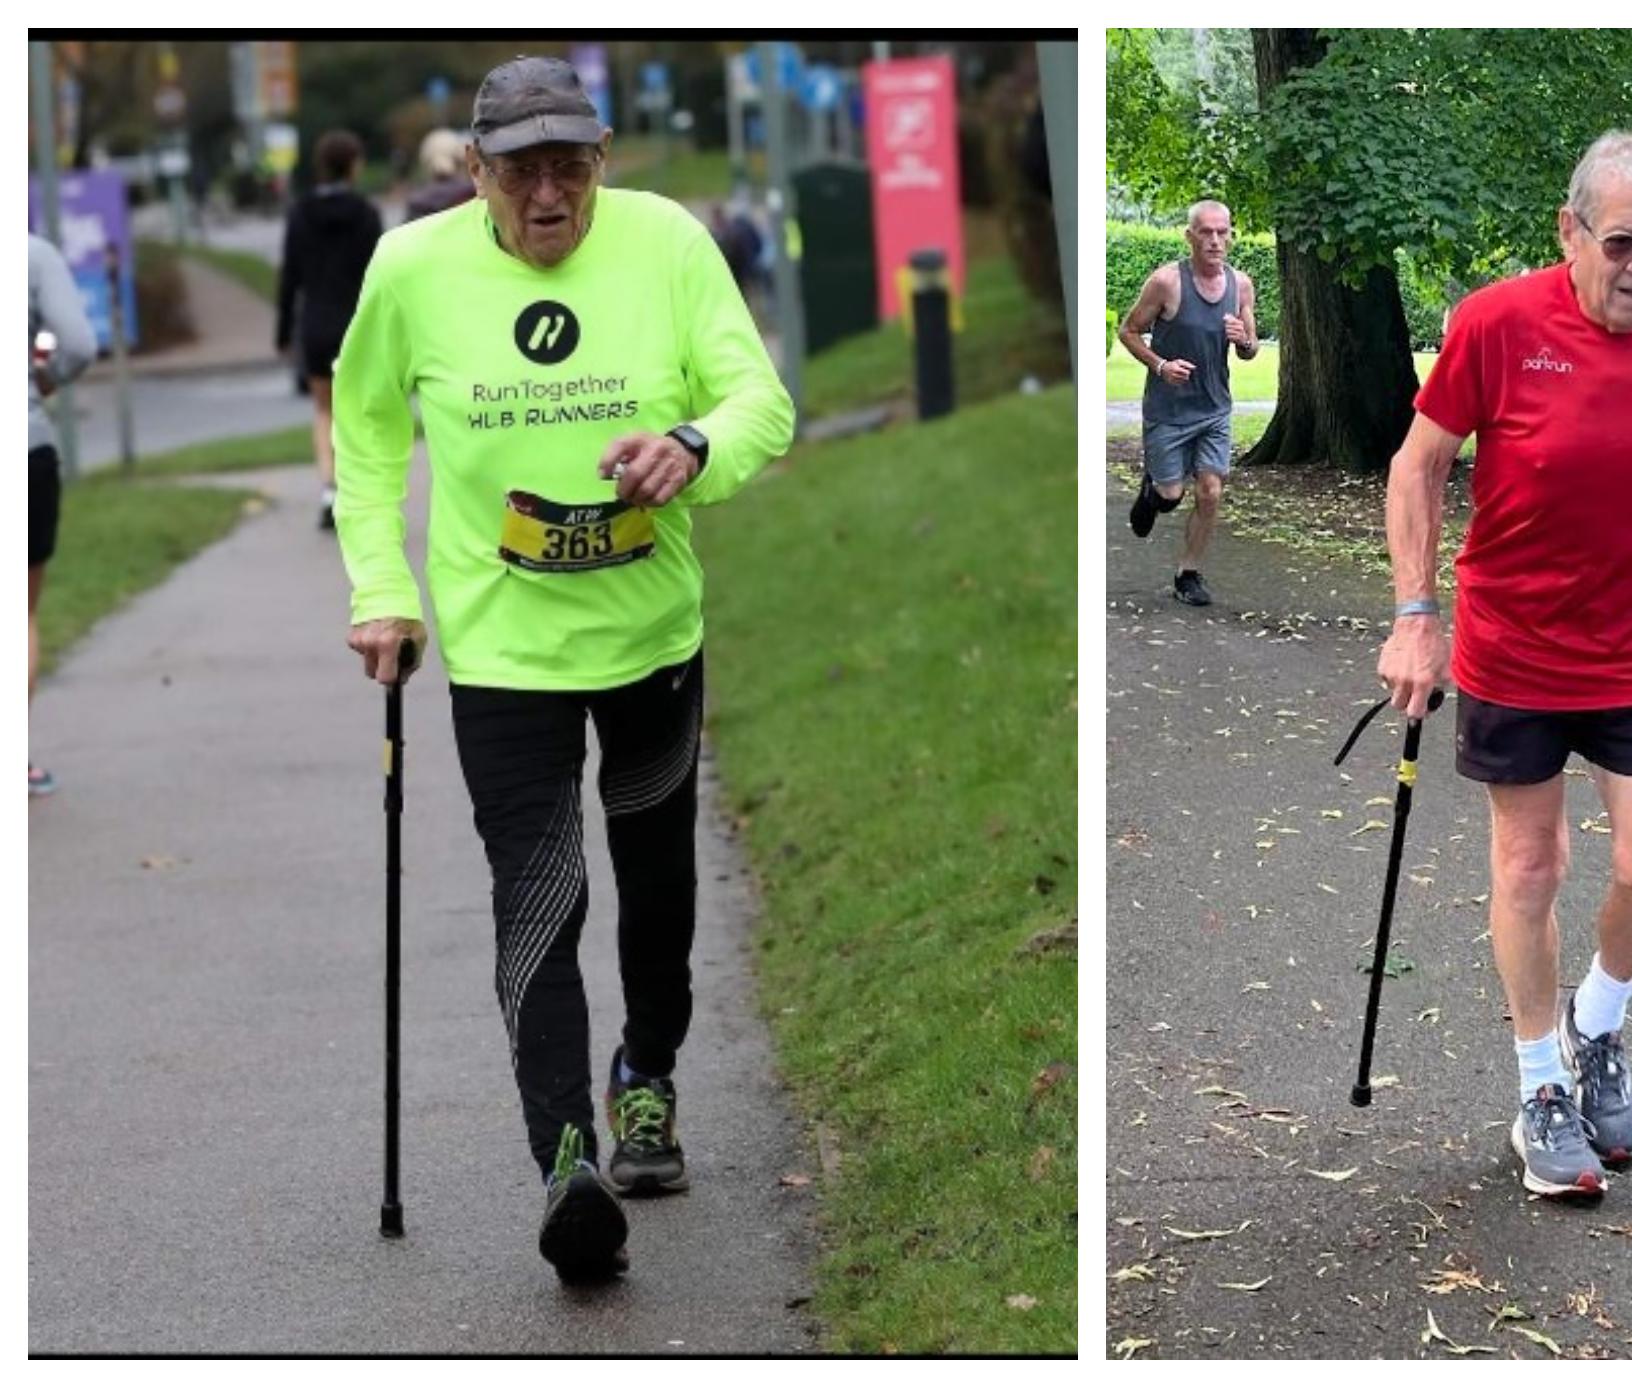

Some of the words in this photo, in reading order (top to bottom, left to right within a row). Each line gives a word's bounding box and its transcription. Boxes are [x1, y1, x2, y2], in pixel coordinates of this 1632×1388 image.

[1521, 353, 1573, 374] parkrun
[472, 375, 628, 403] RunTogether
[524, 400, 639, 427] RUNNERS
[541, 523, 613, 561] 363
